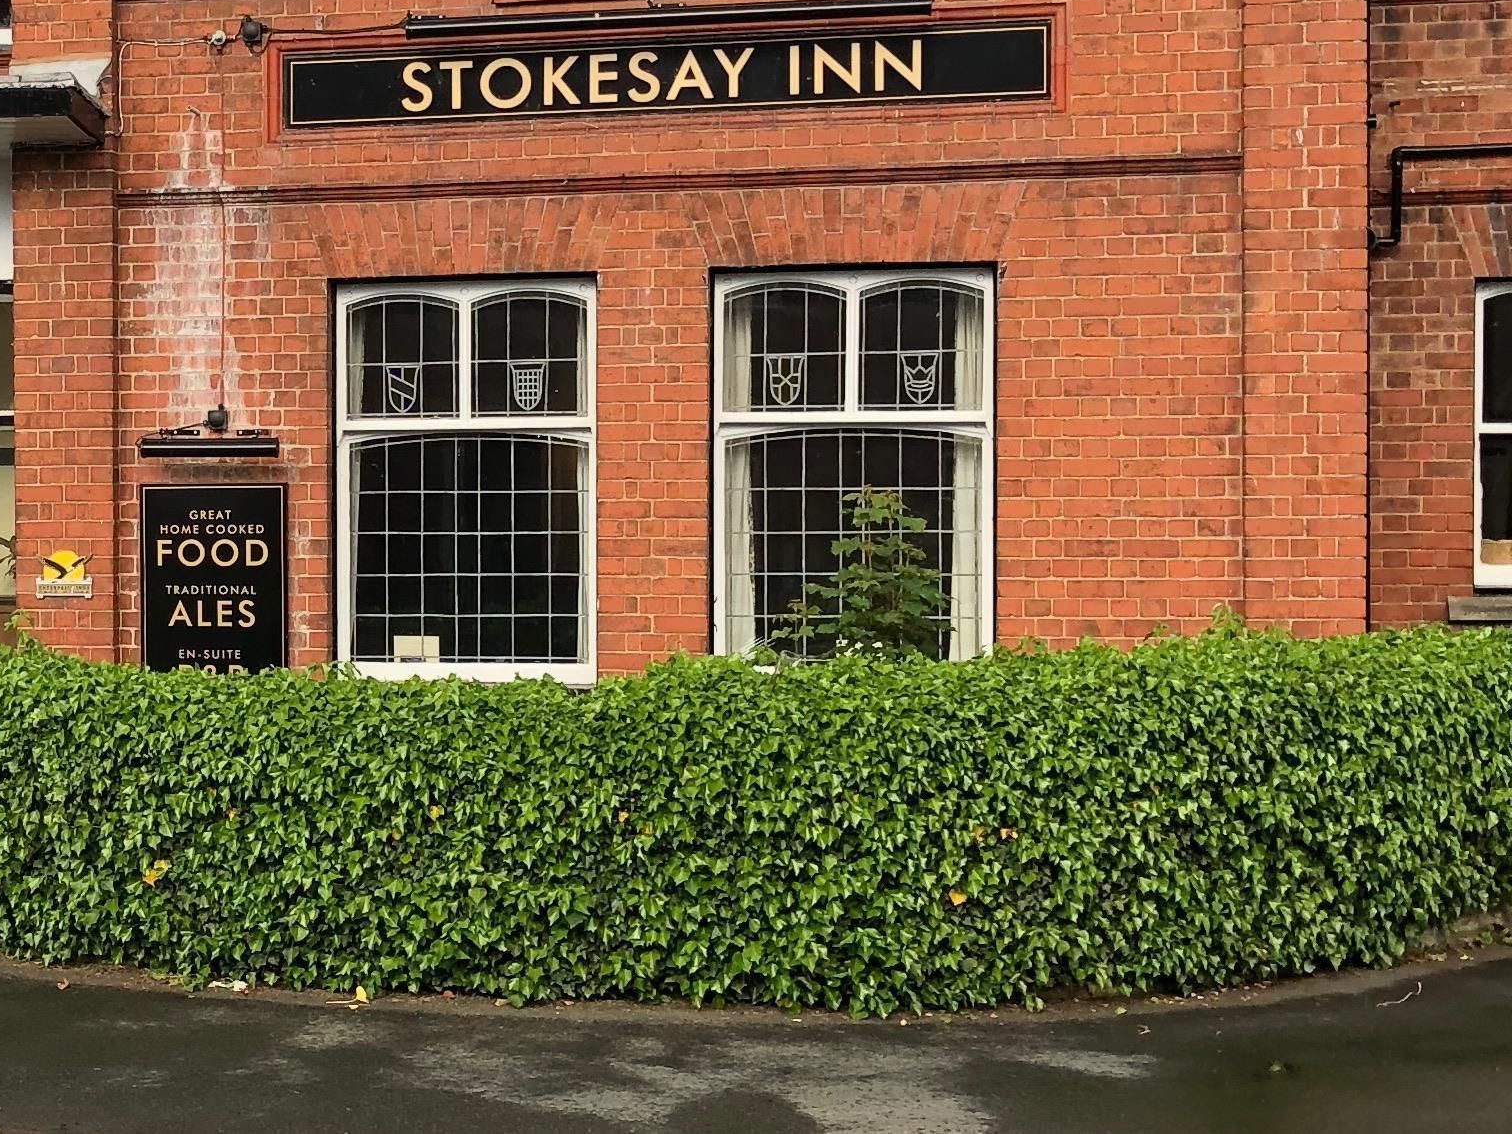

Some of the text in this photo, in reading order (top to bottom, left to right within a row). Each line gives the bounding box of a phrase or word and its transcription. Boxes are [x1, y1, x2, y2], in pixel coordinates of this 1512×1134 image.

[400, 39, 923, 113] STOKESAY INN
[188, 509, 233, 521] GREAT
[160, 524, 266, 535] HOME COOKED
[156, 538, 270, 568] FOOD
[165, 584, 257, 596] TRADITIONAL
[168, 599, 256, 629] ALES
[178, 649, 241, 660] EN-SUITE
